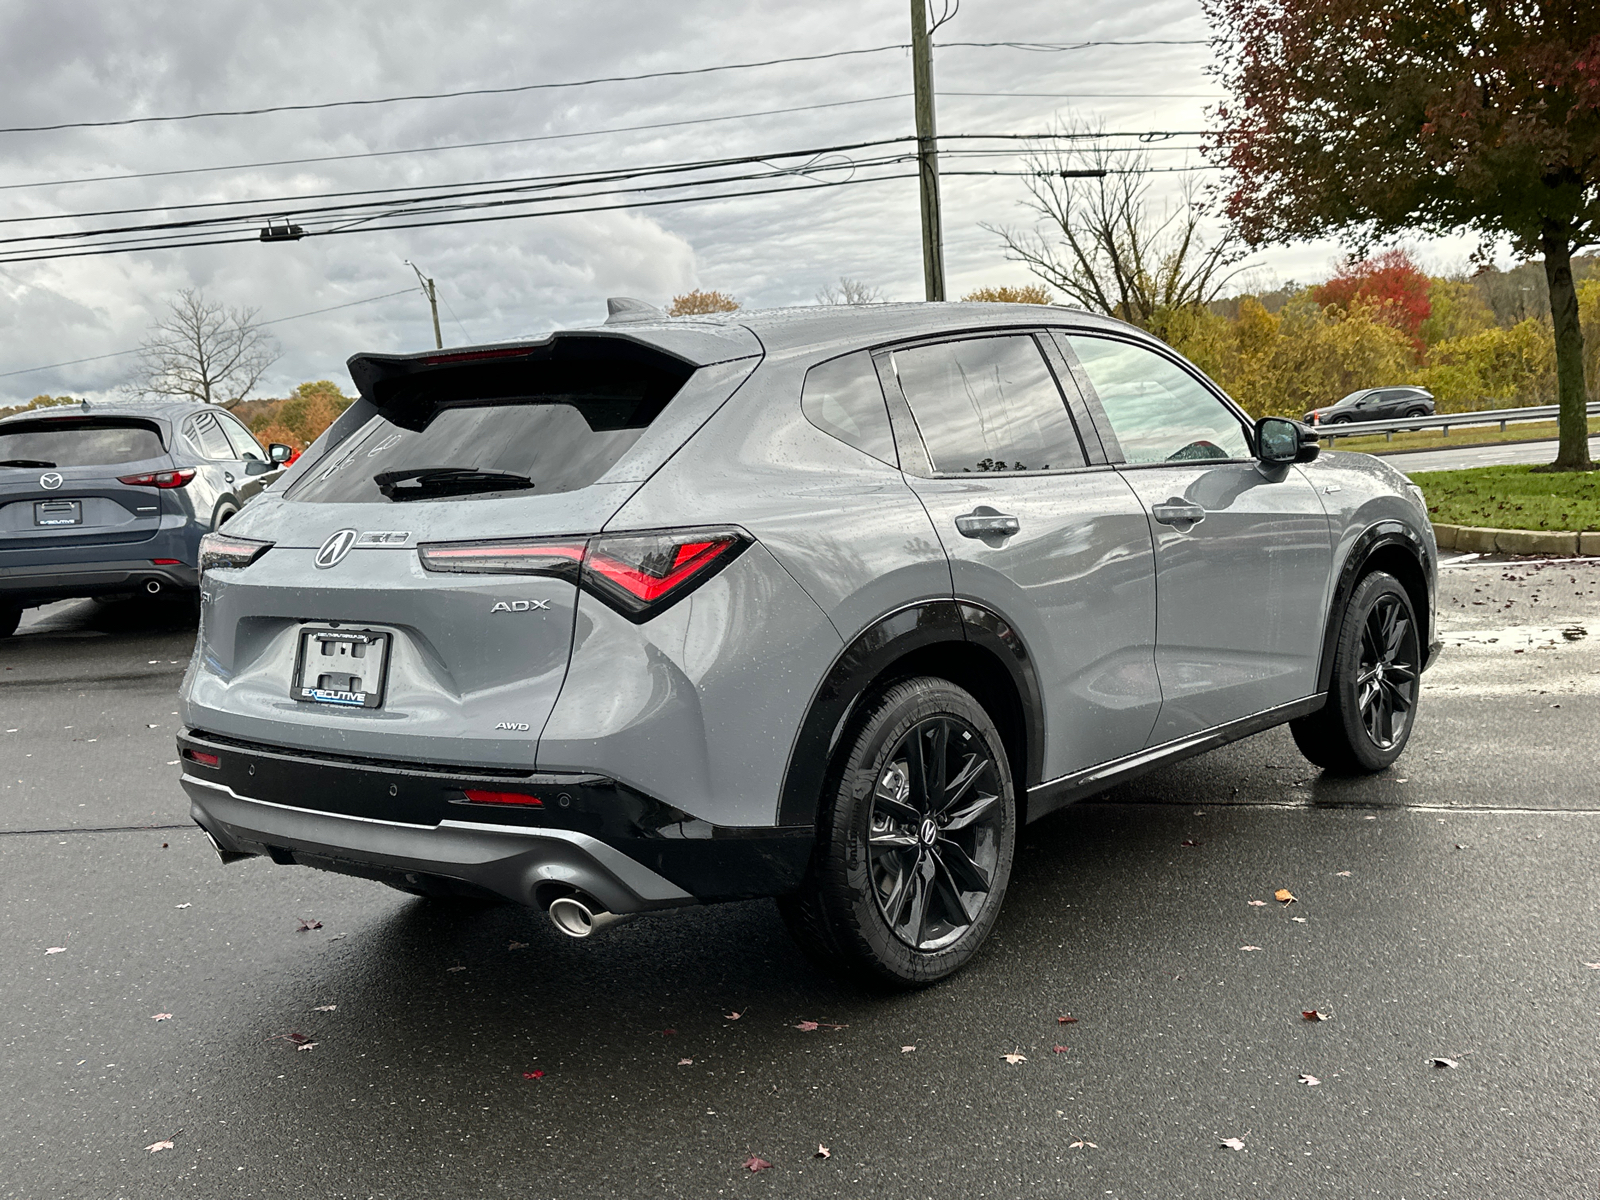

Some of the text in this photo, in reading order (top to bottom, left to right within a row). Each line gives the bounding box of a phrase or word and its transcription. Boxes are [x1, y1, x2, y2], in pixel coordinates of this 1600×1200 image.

[490, 599, 551, 613] ADX
[302, 689, 366, 702] EXECUTIVE
[495, 722, 530, 731] AWD
